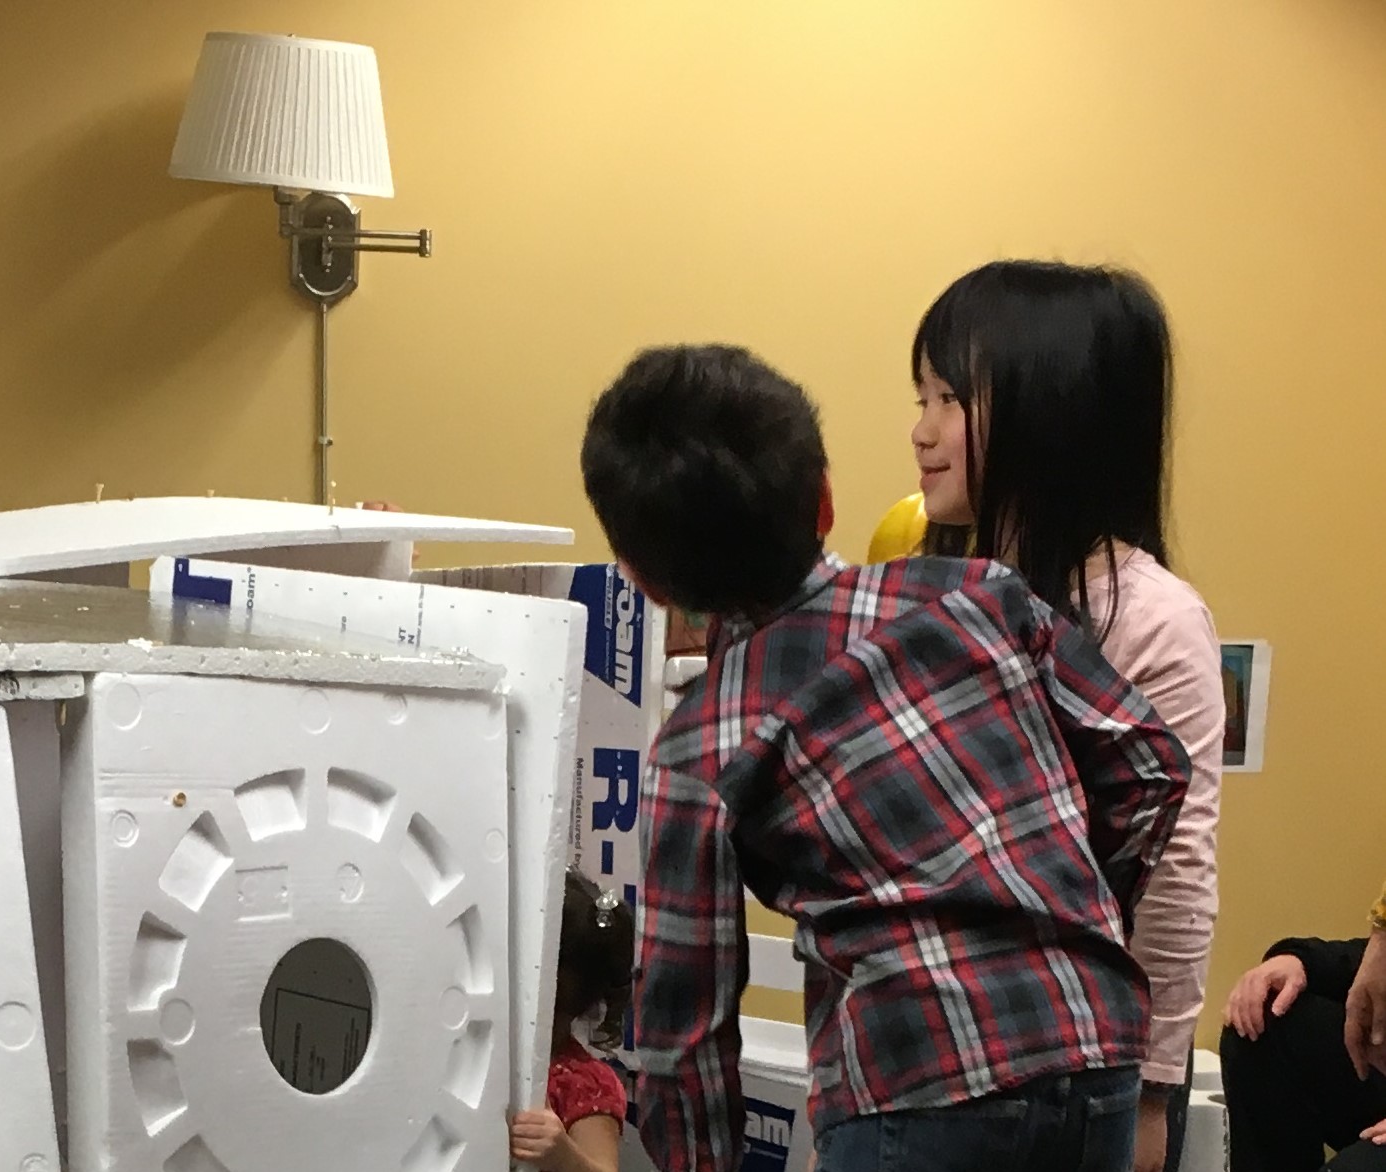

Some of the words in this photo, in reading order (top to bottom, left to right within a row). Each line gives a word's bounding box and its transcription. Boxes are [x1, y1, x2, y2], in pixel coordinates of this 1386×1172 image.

[246, 573, 256, 610] oam
[575, 757, 584, 850] Manufactured
[573, 853, 582, 870] by
[744, 1110, 792, 1148] am
